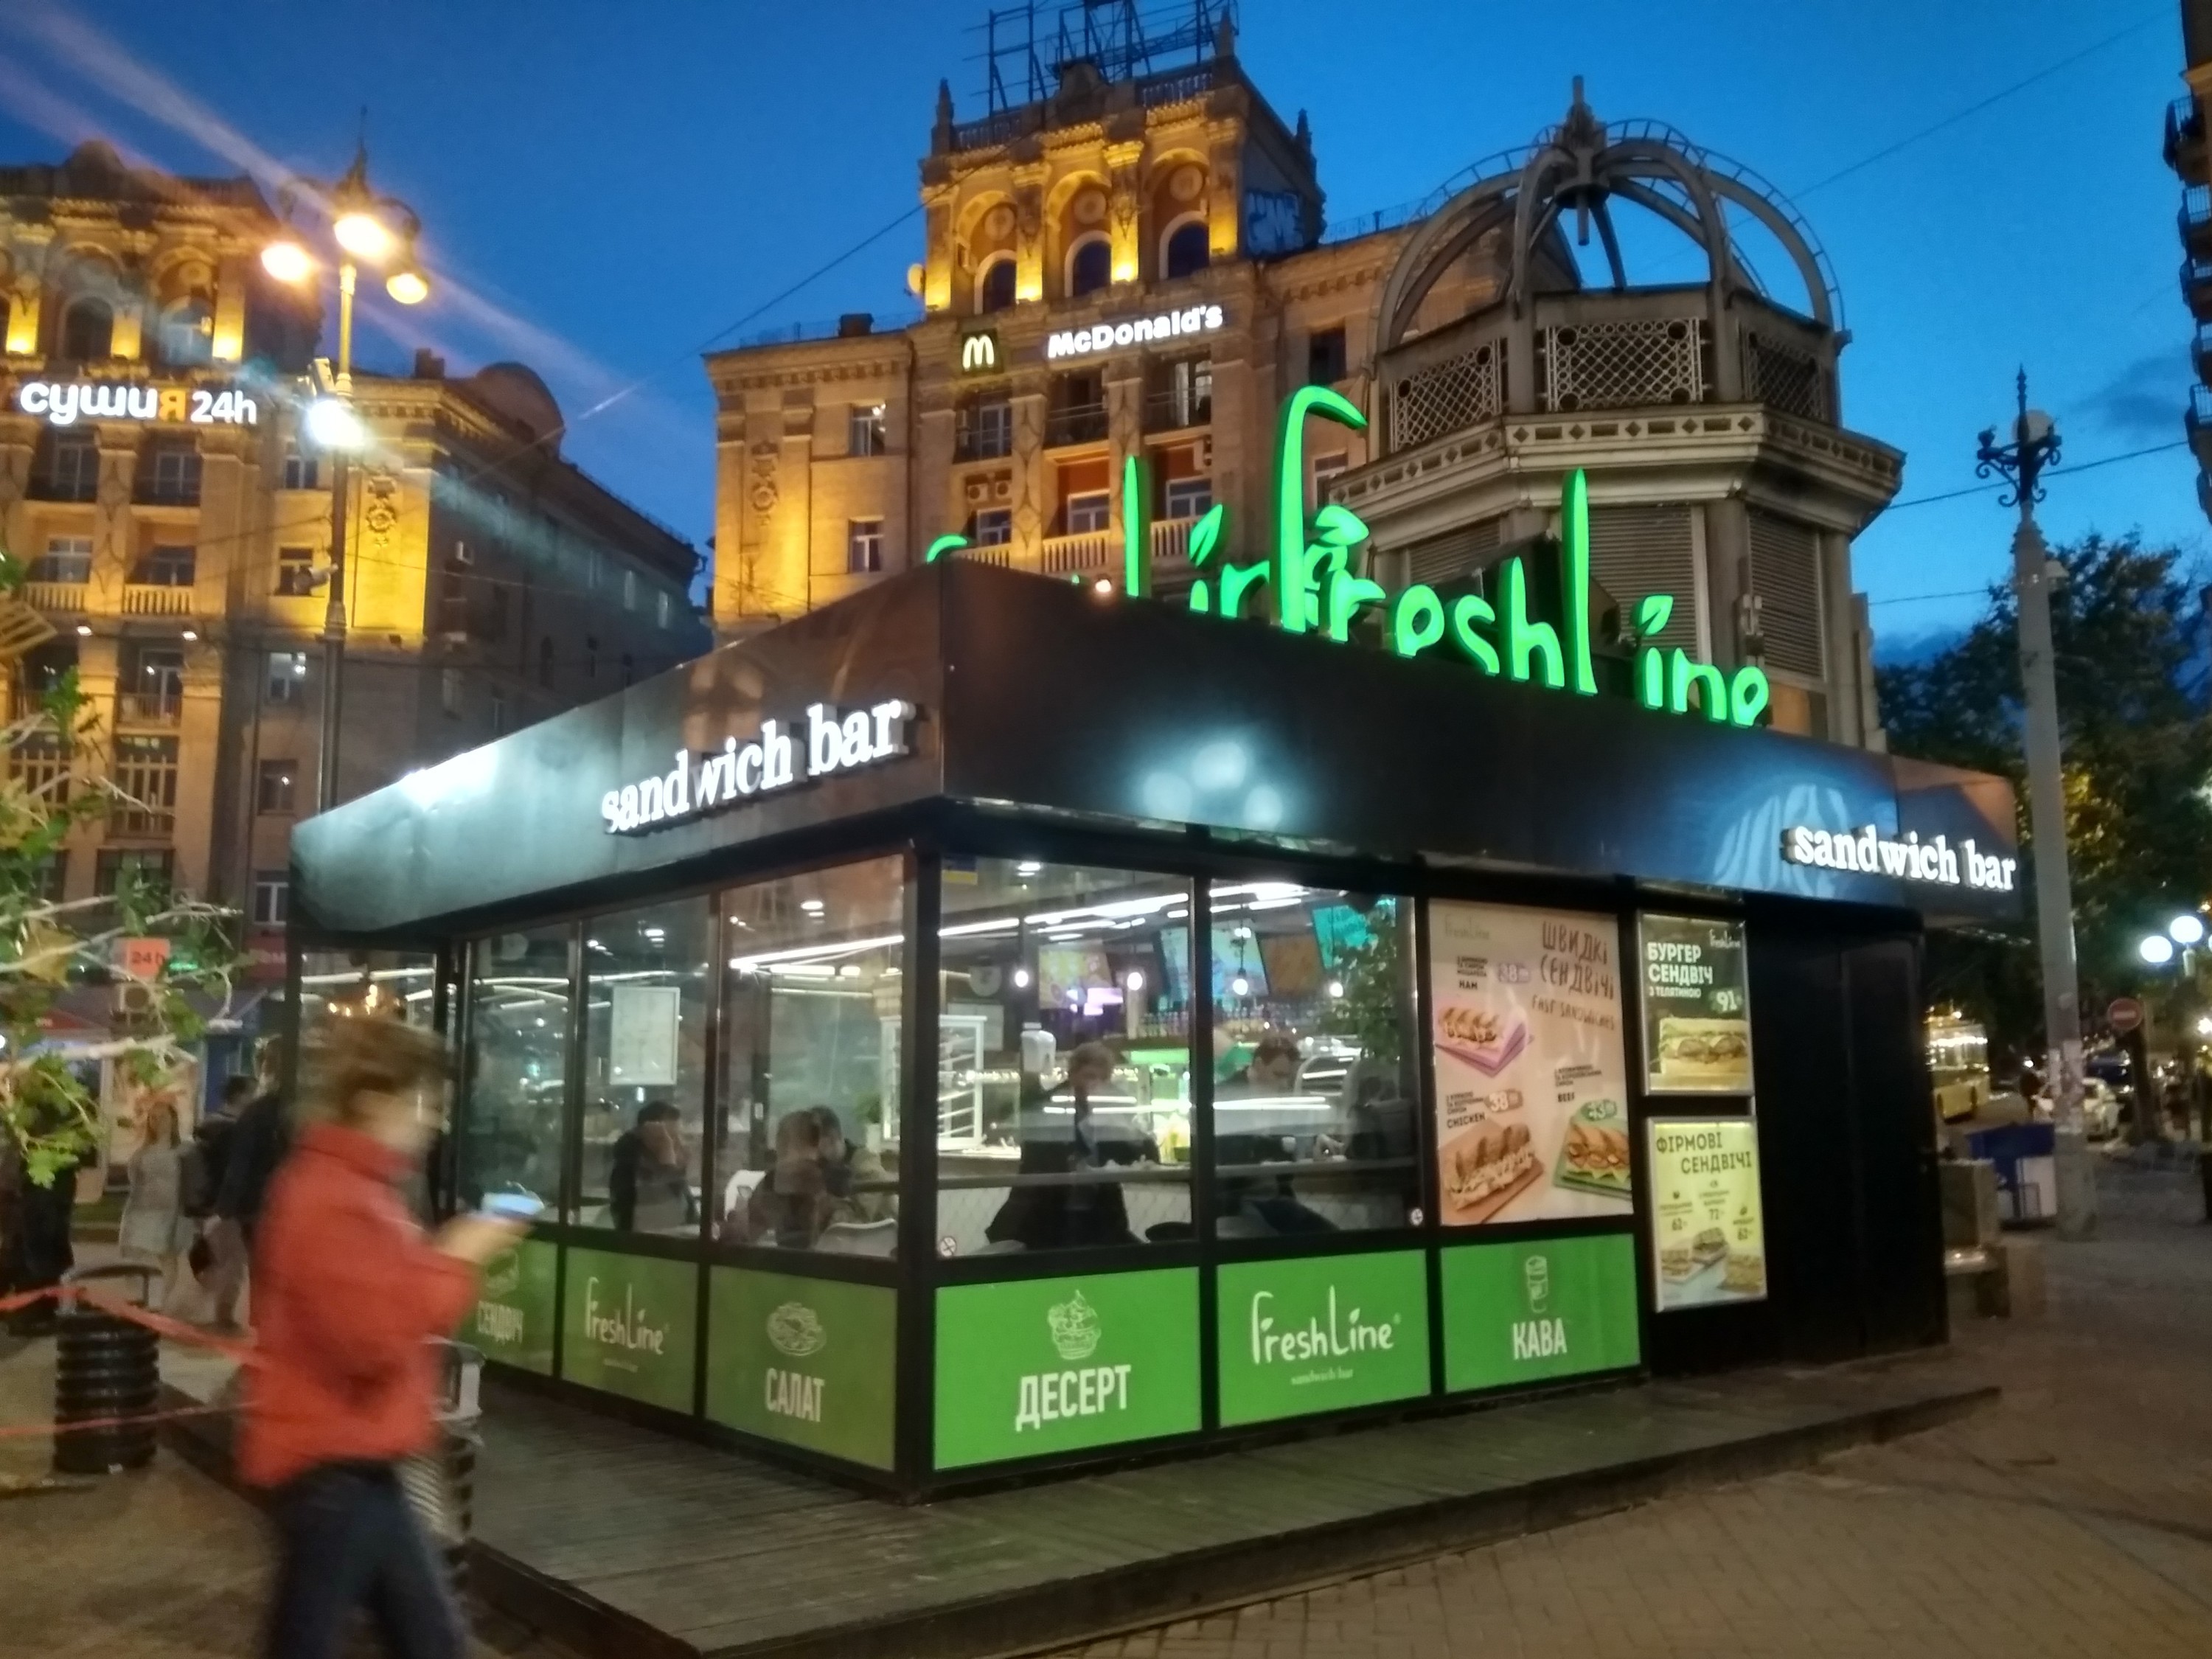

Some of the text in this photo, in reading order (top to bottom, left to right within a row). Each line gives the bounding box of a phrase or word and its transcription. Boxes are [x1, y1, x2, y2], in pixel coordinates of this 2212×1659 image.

[1048, 305, 1223, 358] McDonald's
[191, 391, 257, 424] 24h
[602, 699, 907, 834] sandwich bar
[1792, 824, 2016, 891] sandwich bar
[1647, 942, 1702, 963] БУРГЕР
[1459, 980, 1478, 990] HAM
[1648, 964, 1714, 986] СЕНДВІЧ
[1717, 990, 1738, 1012] 91
[1489, 1091, 1509, 1112] 38
[1447, 1112, 1486, 1129] CHICKEN
[1656, 1132, 1723, 1153] ФІРМОВІ
[1681, 1151, 1753, 1174] СЕНДВІЧІ
[1512, 1317, 1568, 1360] КАВА
[765, 1367, 826, 1423] САЛАТ
[1015, 1364, 1132, 1432] ДЕСЕРТ
